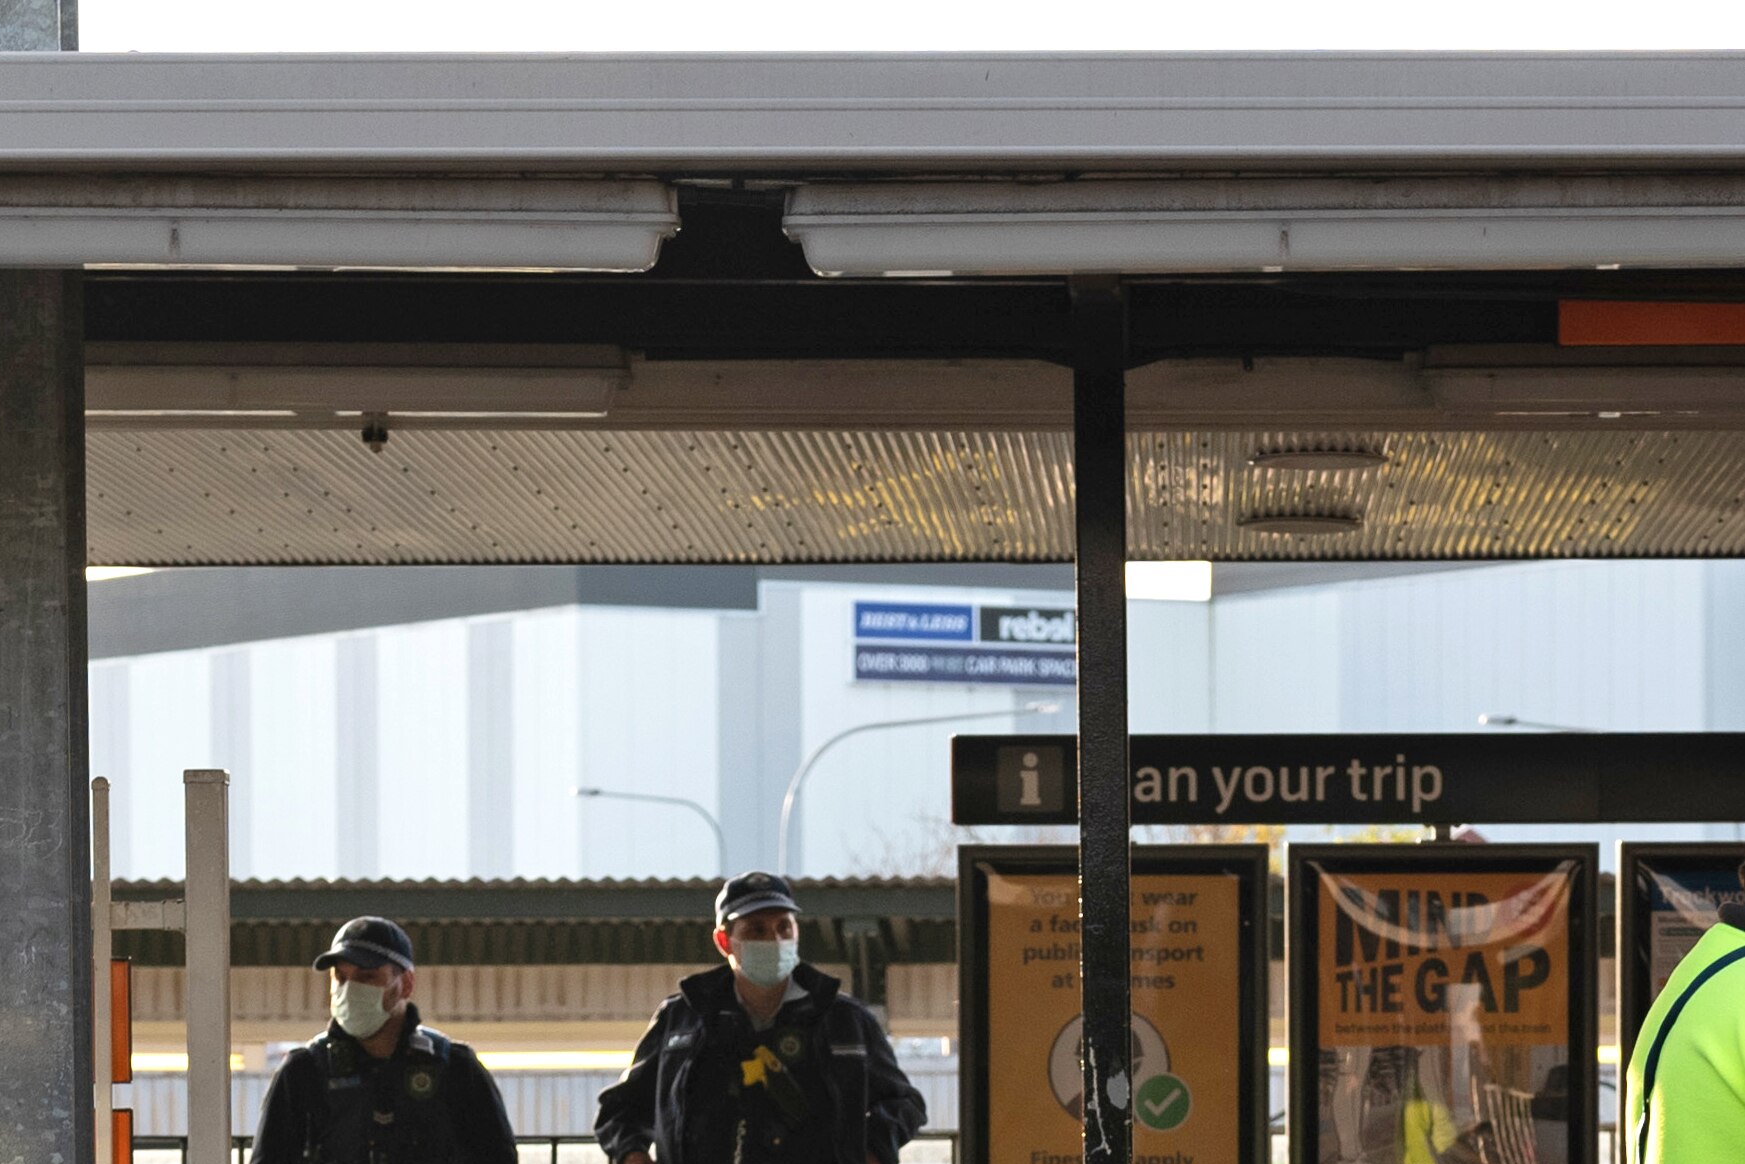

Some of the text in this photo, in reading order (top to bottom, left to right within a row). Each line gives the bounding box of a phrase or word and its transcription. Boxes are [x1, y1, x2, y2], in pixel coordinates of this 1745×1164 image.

[999, 610, 1075, 641] rebel
[1133, 754, 1444, 814] an your trip
[1142, 890, 1199, 907] wear
[1029, 918, 1042, 934] a
[1050, 914, 1080, 934] fac
[1168, 918, 1198, 934] on
[1335, 887, 1494, 968] MIND
[1023, 943, 1205, 966] publi nsport
[1051, 974, 1176, 990] at mes
[1335, 944, 1551, 1014] THE GAP
